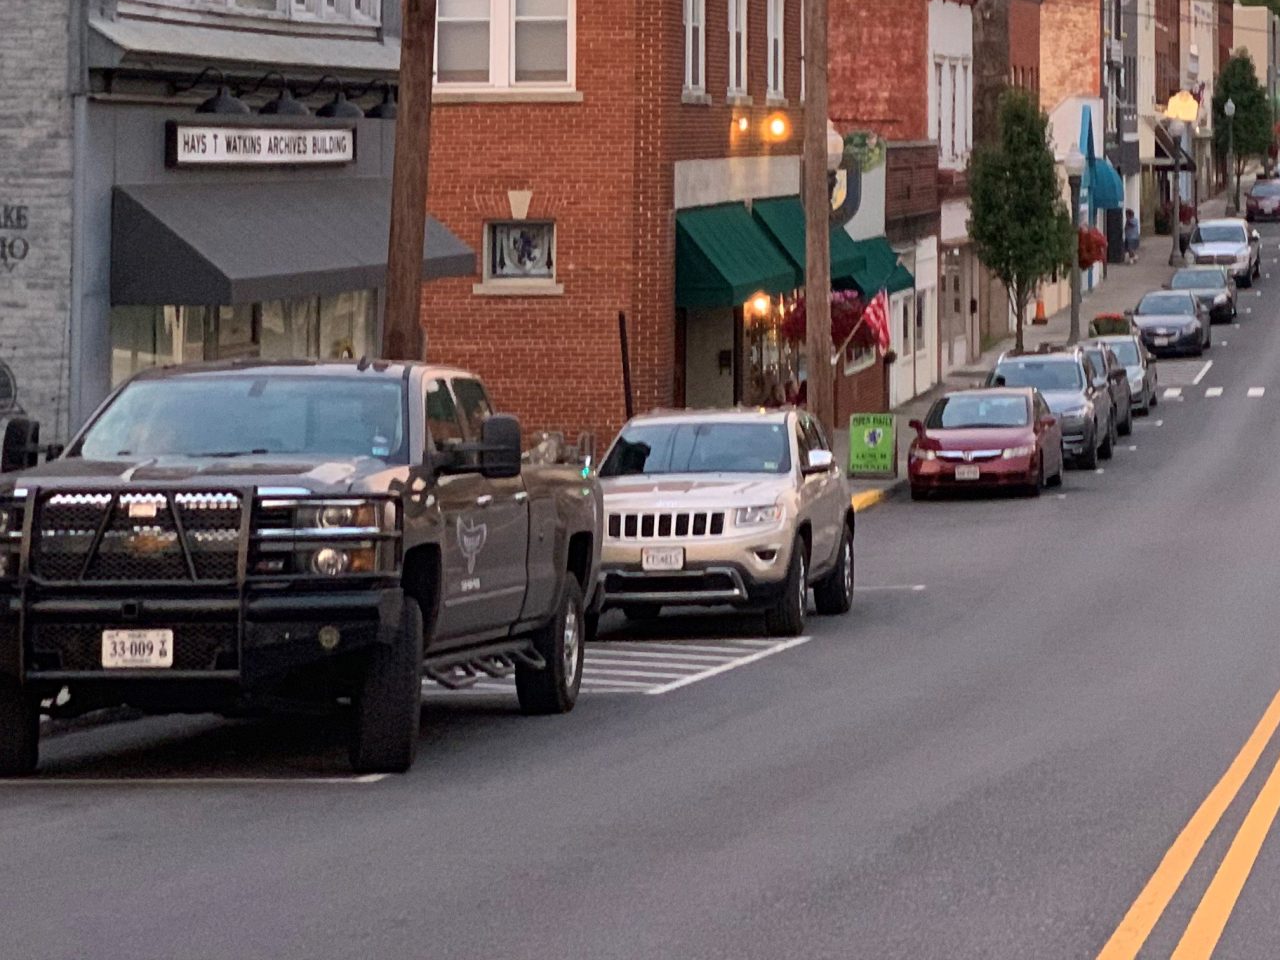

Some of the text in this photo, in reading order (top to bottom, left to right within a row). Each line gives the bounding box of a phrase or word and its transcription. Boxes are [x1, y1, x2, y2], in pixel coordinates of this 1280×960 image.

[183, 134, 207, 154] HAYS
[225, 135, 262, 154] WATKINS
[267, 136, 308, 154] ARCHIVES
[312, 137, 347, 154] BUILDING
